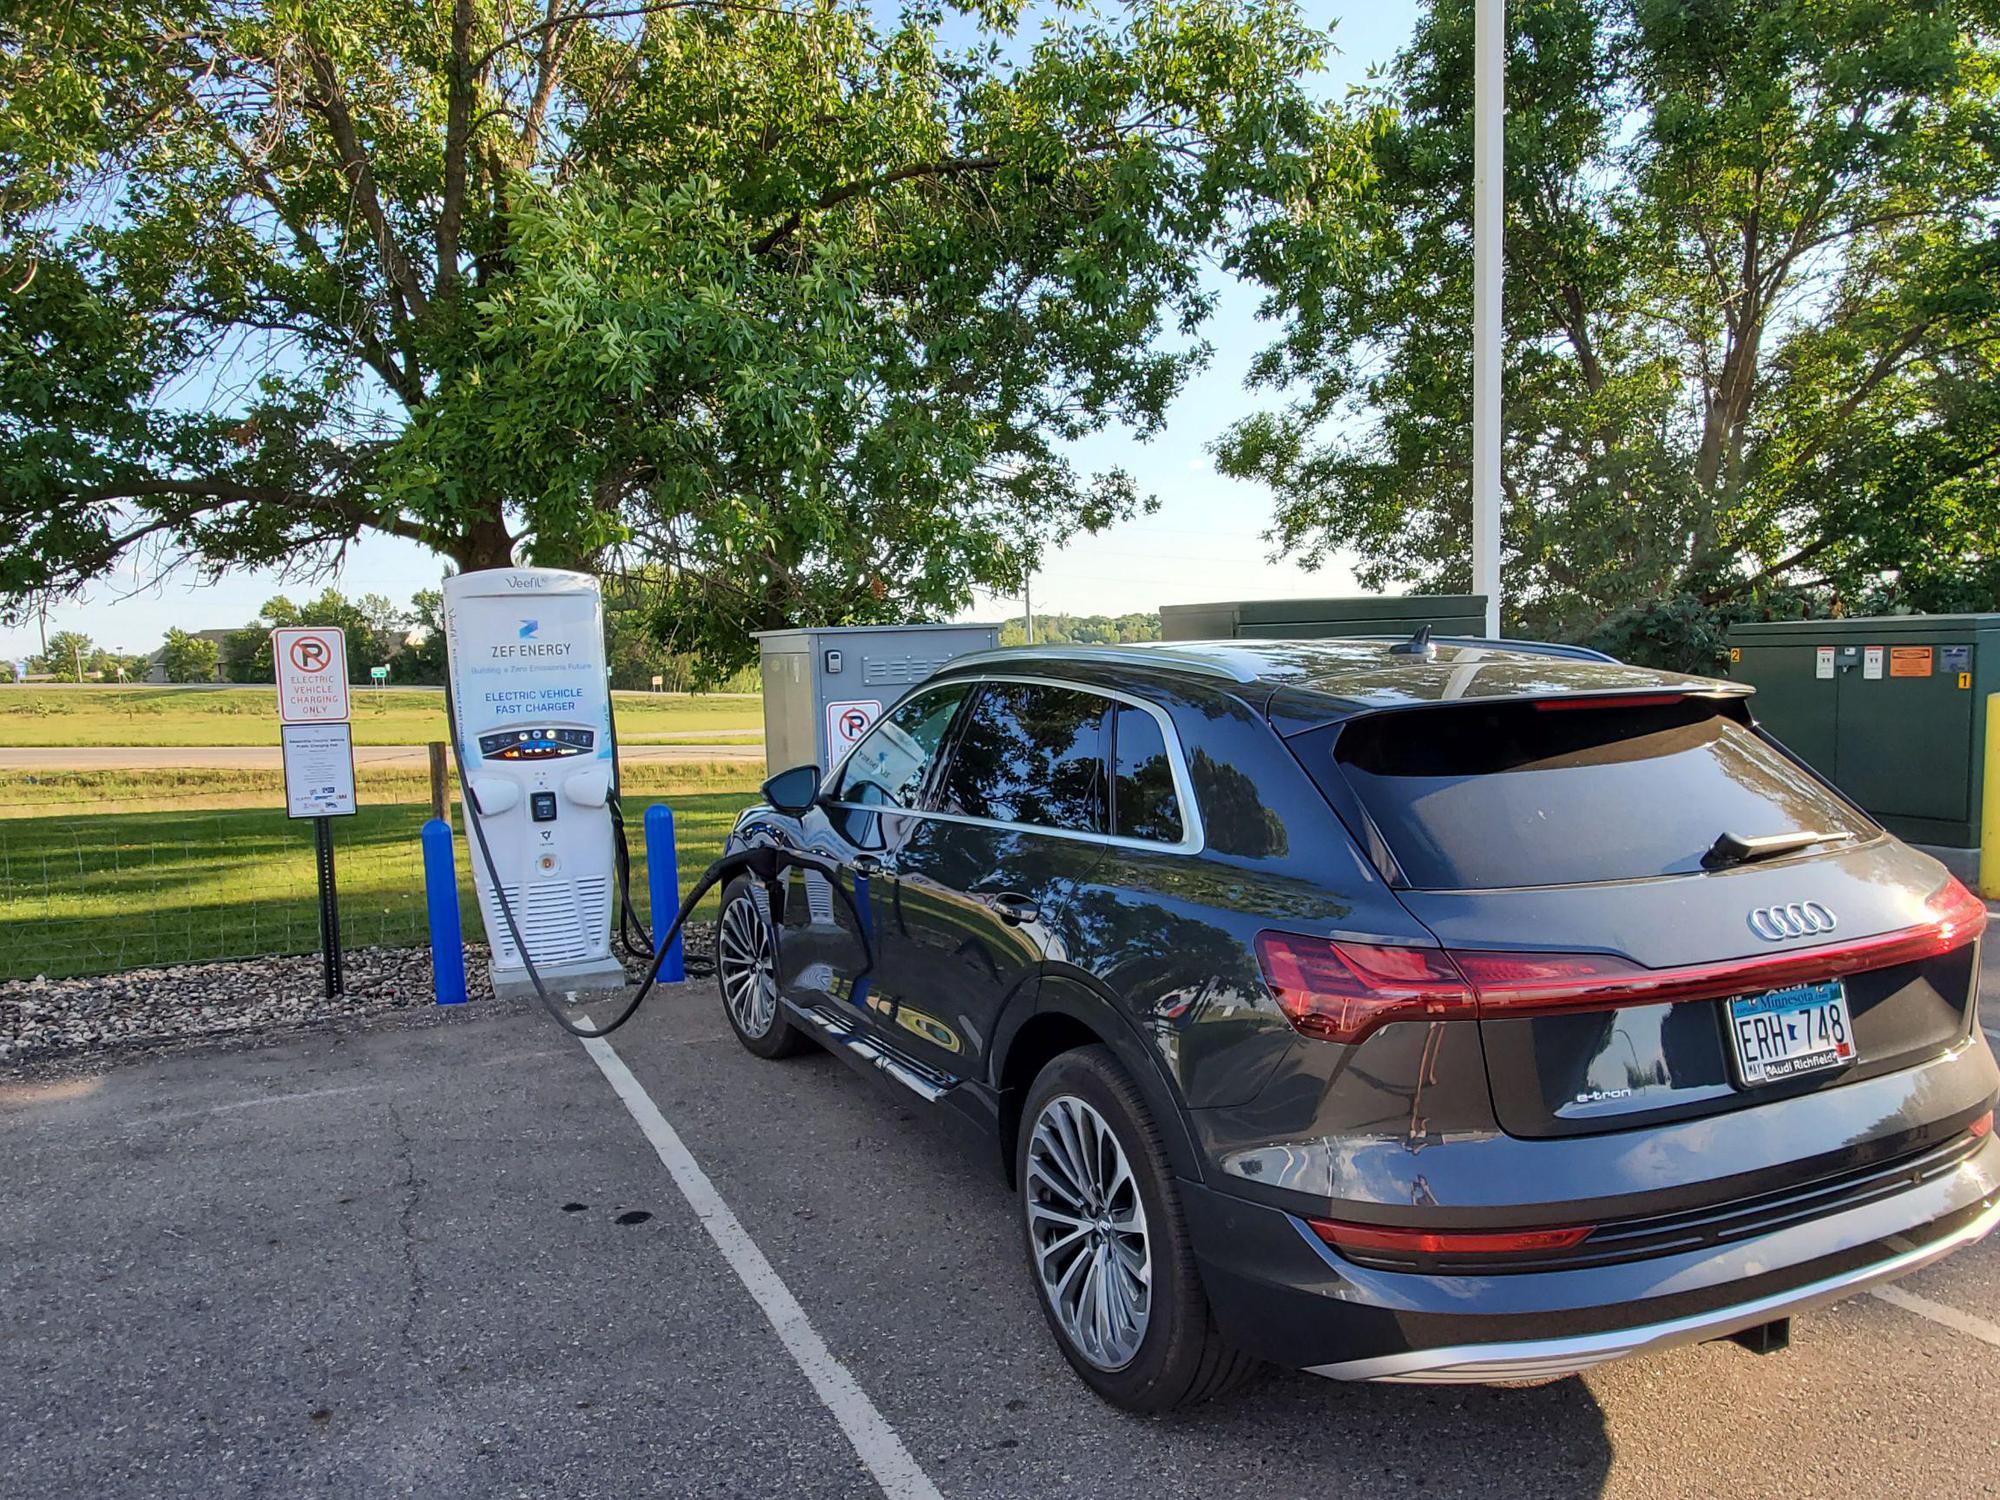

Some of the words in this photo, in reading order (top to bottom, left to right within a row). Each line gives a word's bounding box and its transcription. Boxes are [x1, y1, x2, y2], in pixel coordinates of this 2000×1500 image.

[505, 575, 542, 589] Veefil
[492, 646, 516, 658] ZEF
[520, 643, 571, 657] ENERGY
[290, 675, 335, 685] ELECTRIC
[294, 685, 333, 695] VEHICLE
[485, 690, 537, 702] ELECTRIC
[540, 688, 583, 699] VEHICLE
[290, 695, 339, 705] CHARGING
[302, 705, 328, 715] ONLY
[496, 704, 522, 715] FAST
[526, 701, 575, 713] CHARGER
[1739, 1014, 1787, 1062] ERH
[1799, 1004, 1845, 1050] 748
[1769, 1064, 1793, 1076] Audi
[1793, 1053, 1834, 1070] Richfield
[1577, 1088, 1632, 1103] e-tron
